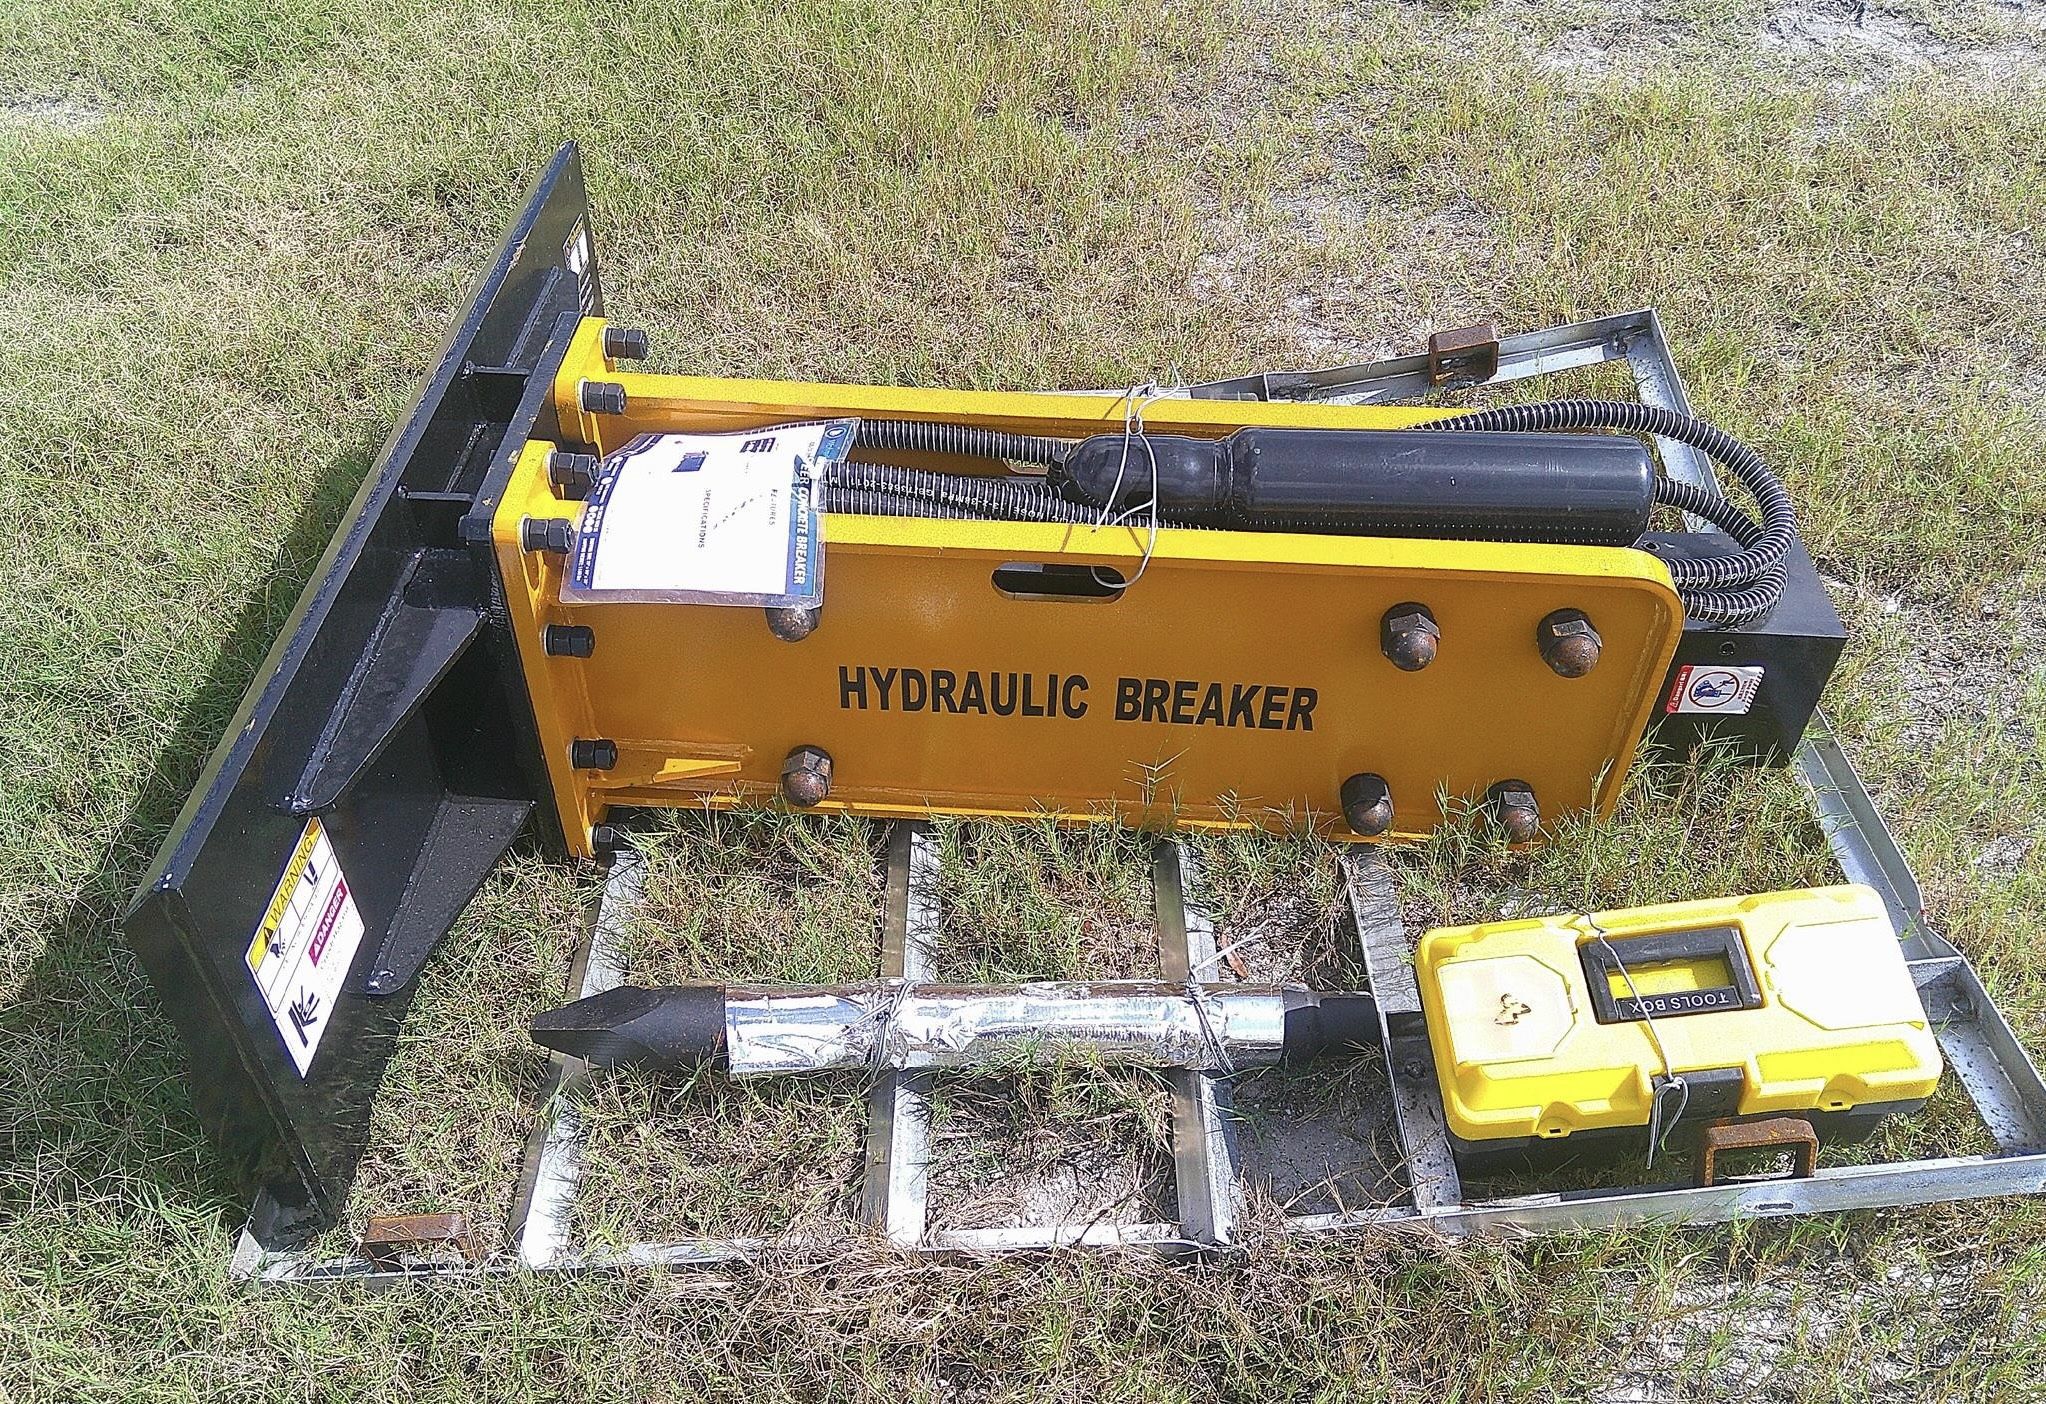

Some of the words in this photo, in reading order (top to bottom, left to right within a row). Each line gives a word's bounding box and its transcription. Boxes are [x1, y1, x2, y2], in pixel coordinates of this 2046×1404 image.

[698, 488, 711, 548] SPECIFICATIONS
[793, 536, 808, 585] BREAKER
[838, 665, 1090, 719] HYDRAULIC
[1114, 677, 1319, 731] BREAKER
[271, 836, 313, 924] WARNING
[317, 887, 344, 946] DANGER
[1628, 998, 1667, 1014] BOX
[1669, 992, 1730, 1010] TOOLS
